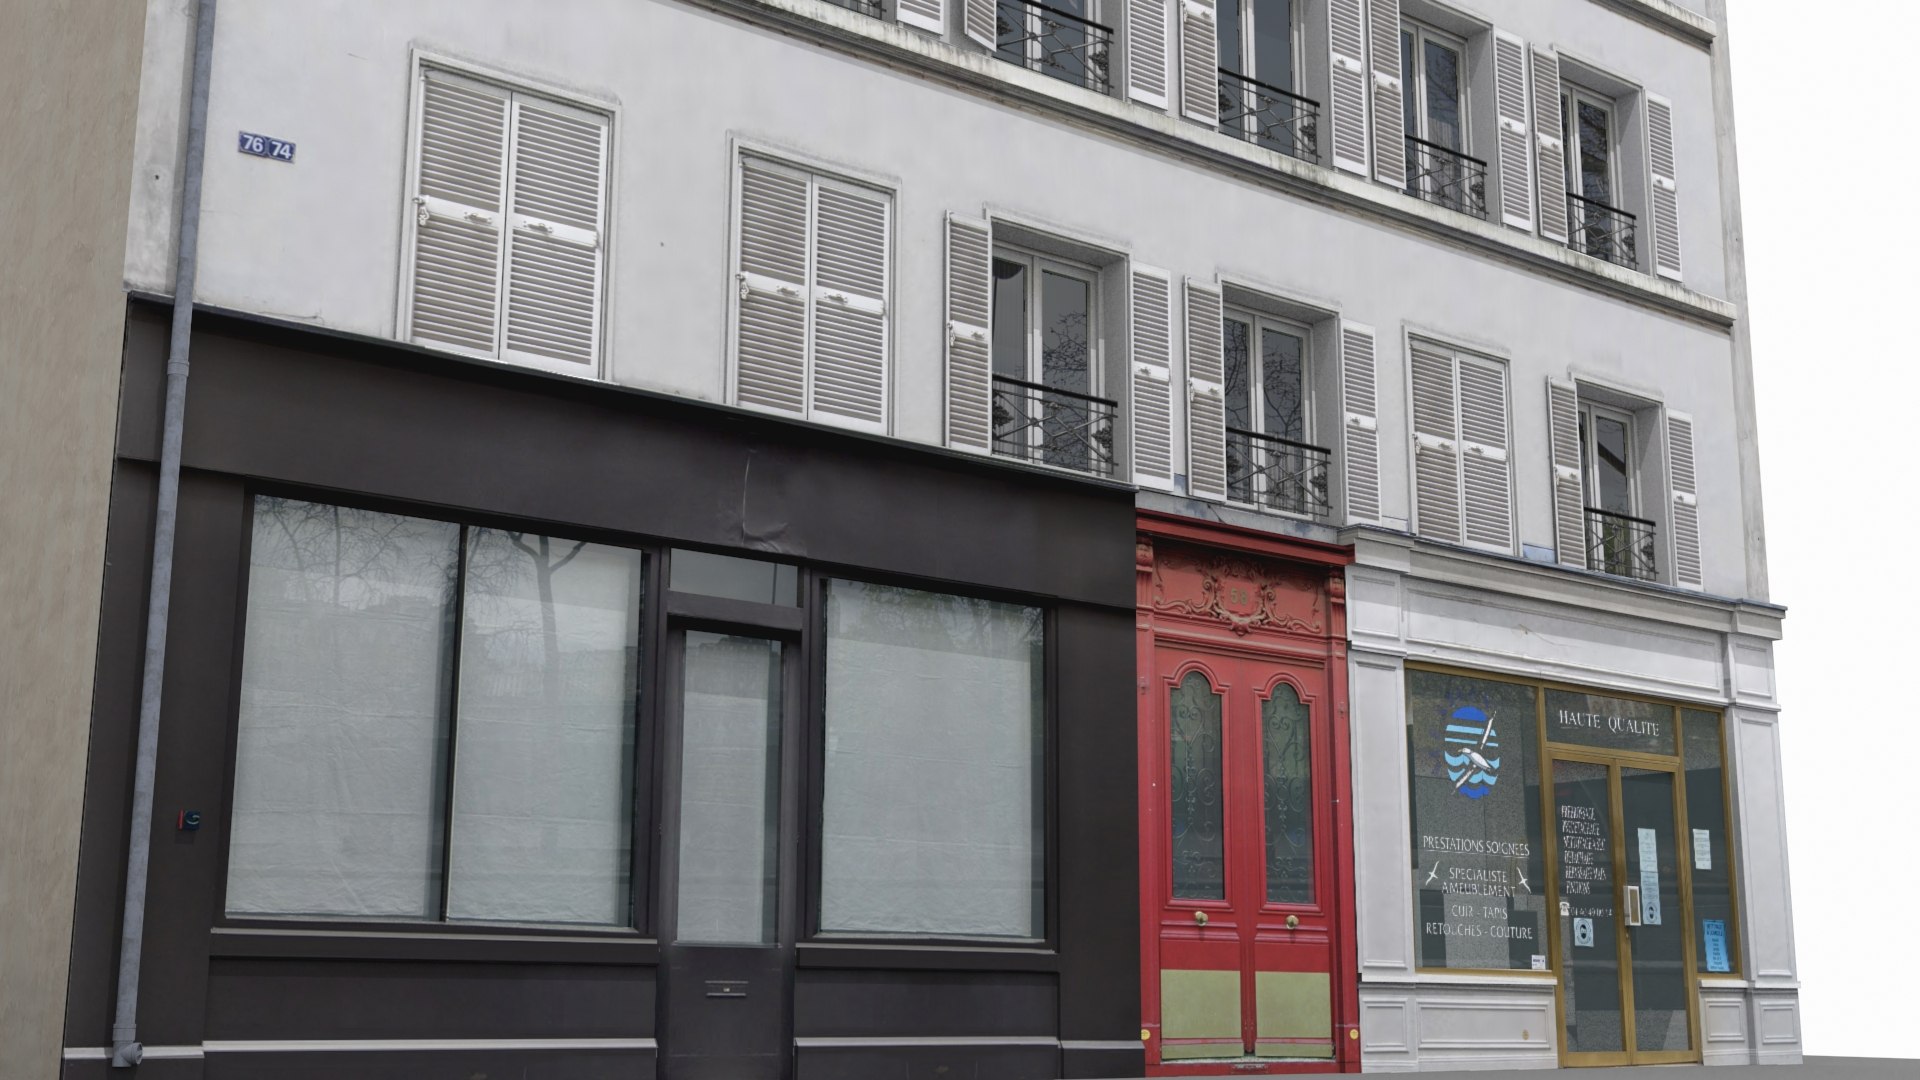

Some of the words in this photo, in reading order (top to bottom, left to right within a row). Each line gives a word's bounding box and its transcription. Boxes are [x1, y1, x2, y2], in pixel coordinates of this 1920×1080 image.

[243, 134, 264, 153] 76
[271, 140, 292, 159] 74
[1559, 709, 1601, 729] HAUTE
[1608, 715, 1660, 737] QUALITE
[1423, 835, 1484, 853] PRESTATIONS
[1485, 840, 1530, 857] SOIGNEES
[1449, 867, 1508, 883] SPECIALISTE
[1441, 881, 1516, 897] AMEUBLEMENT
[1451, 904, 1474, 918] CUIR
[1483, 906, 1508, 920] TAPIS
[1426, 922, 1482, 937] RETOUCHES
[1490, 925, 1533, 940] COUTURE
